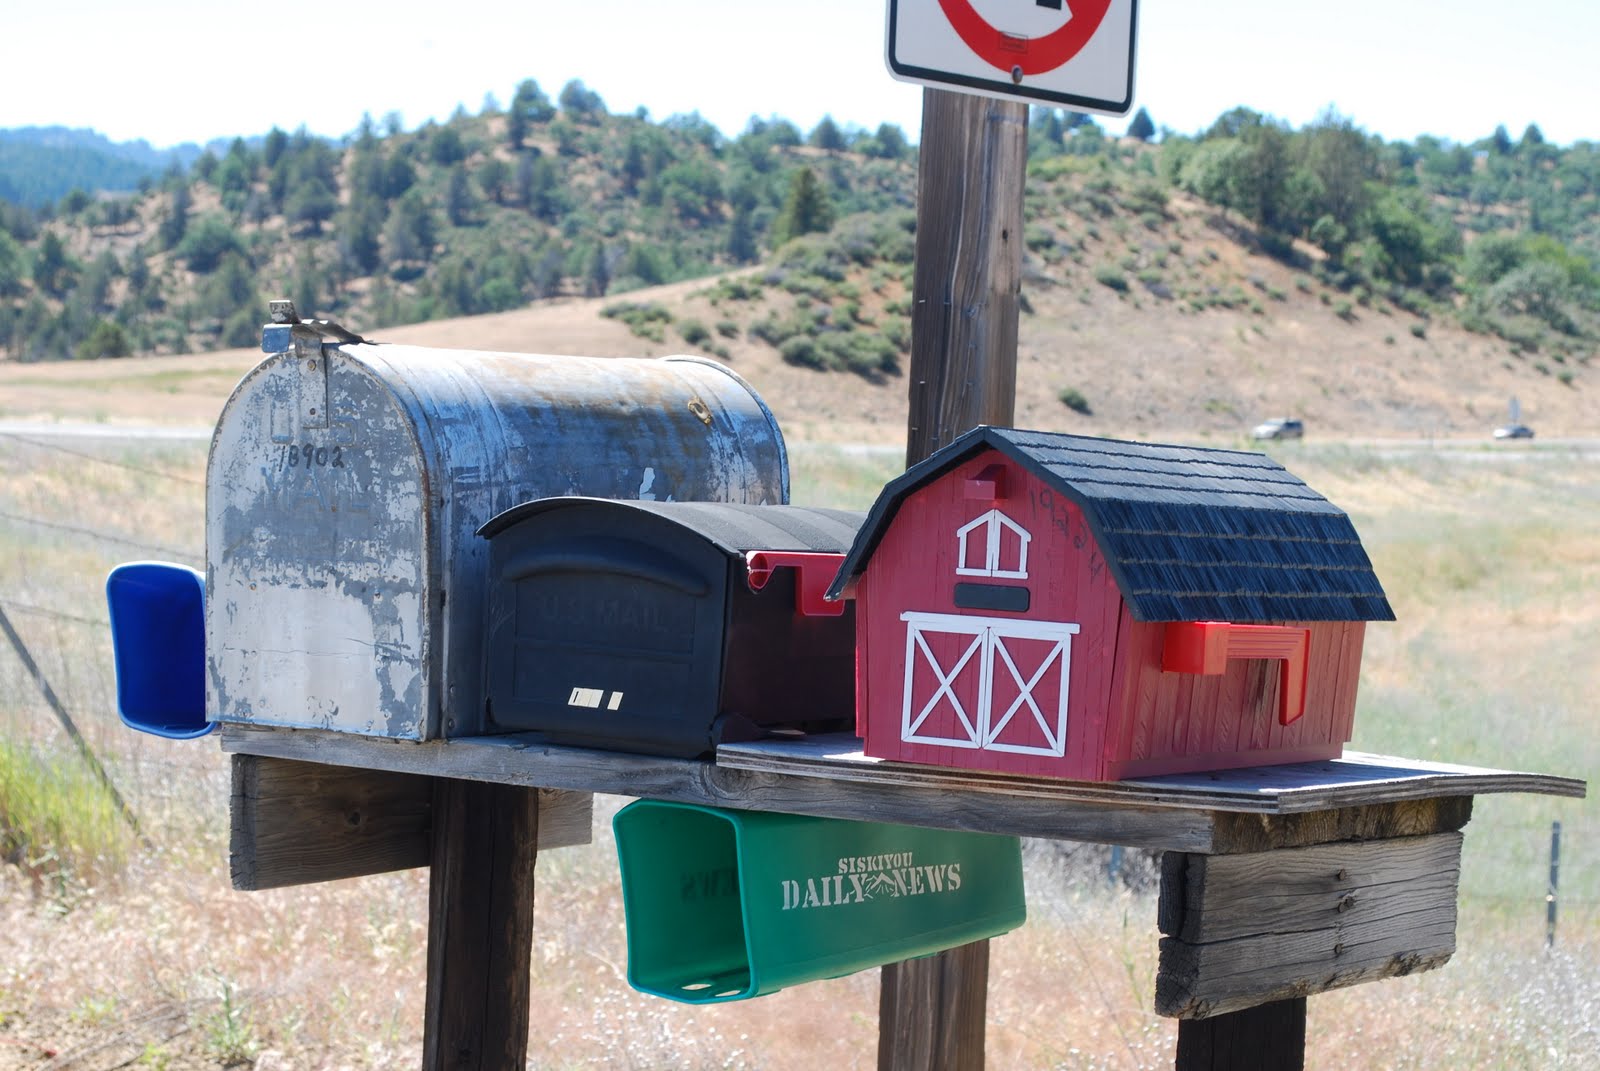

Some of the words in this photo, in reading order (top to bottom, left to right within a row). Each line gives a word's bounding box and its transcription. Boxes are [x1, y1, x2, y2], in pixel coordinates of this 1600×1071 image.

[278, 443, 345, 472] 18902
[838, 852, 913, 874] SISKIYOU
[781, 872, 868, 910] DAILY
[891, 863, 961, 898] NEWS
